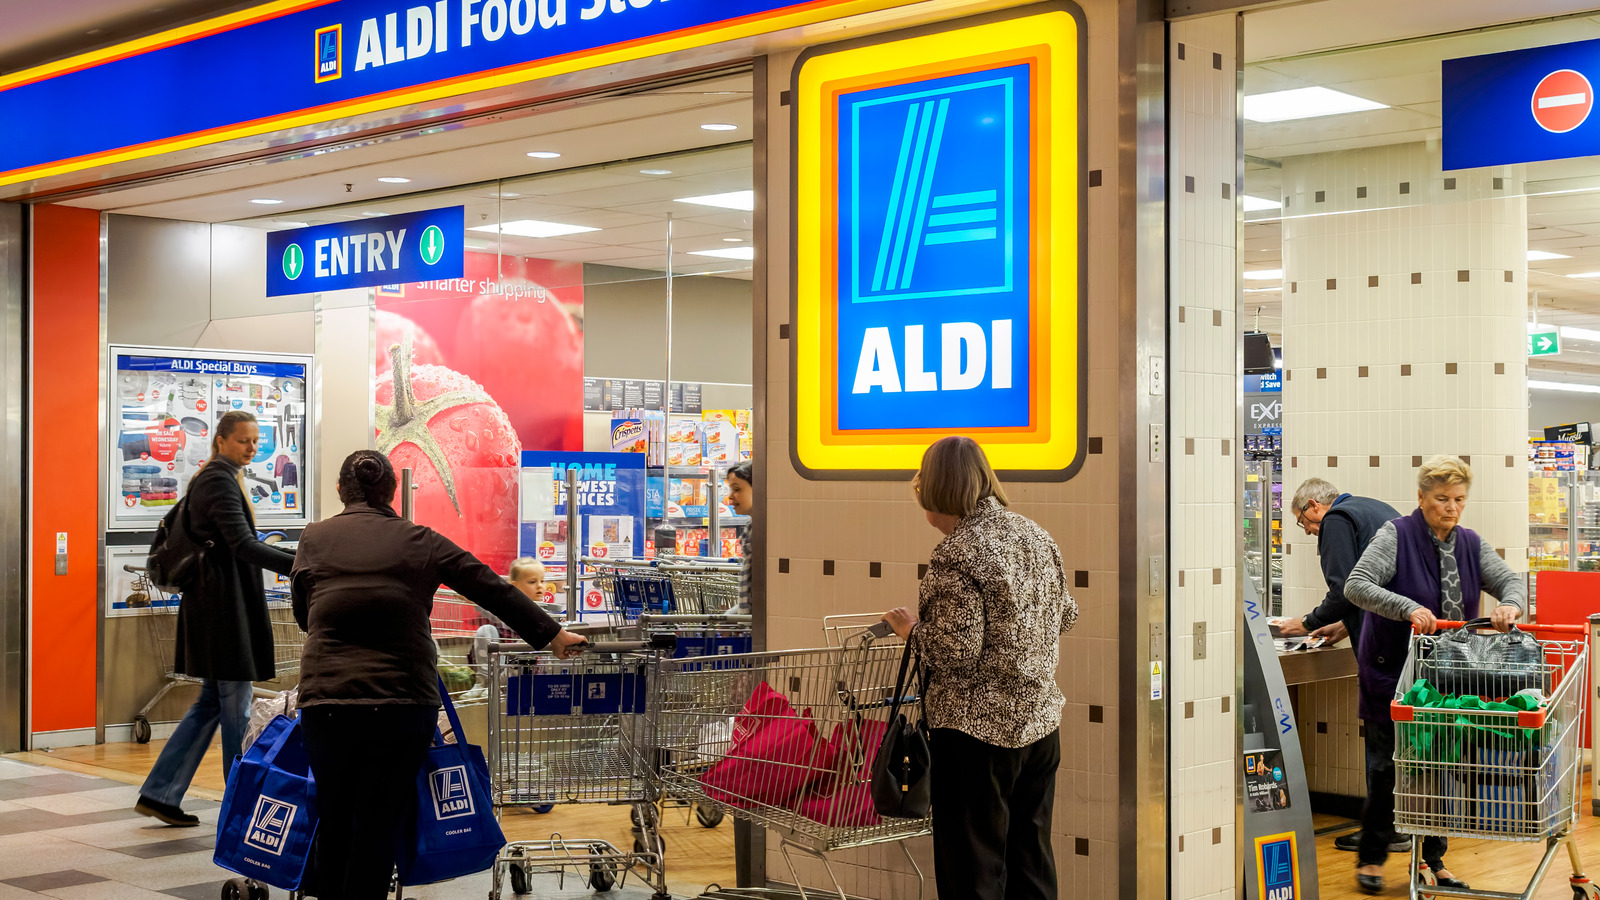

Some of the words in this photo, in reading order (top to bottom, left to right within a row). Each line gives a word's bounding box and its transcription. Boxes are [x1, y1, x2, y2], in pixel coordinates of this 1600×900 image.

[354, 0, 448, 72] ALDI
[320, 61, 337, 74] ALDI
[314, 228, 407, 278] ENTRY
[479, 277, 547, 303] shopping
[851, 318, 1013, 394] ALDI
[171, 359, 194, 370] ALDI
[195, 360, 231, 373] Special
[233, 362, 257, 374] Buys
[614, 424, 642, 441] Crispetts
[550, 462, 617, 480] HOME
[559, 480, 616, 492] LWEST
[441, 800, 469, 814] ALDI
[251, 831, 280, 848] ALDI
[244, 857, 260, 868] COOLER
[1268, 885, 1293, 900] ALDI
